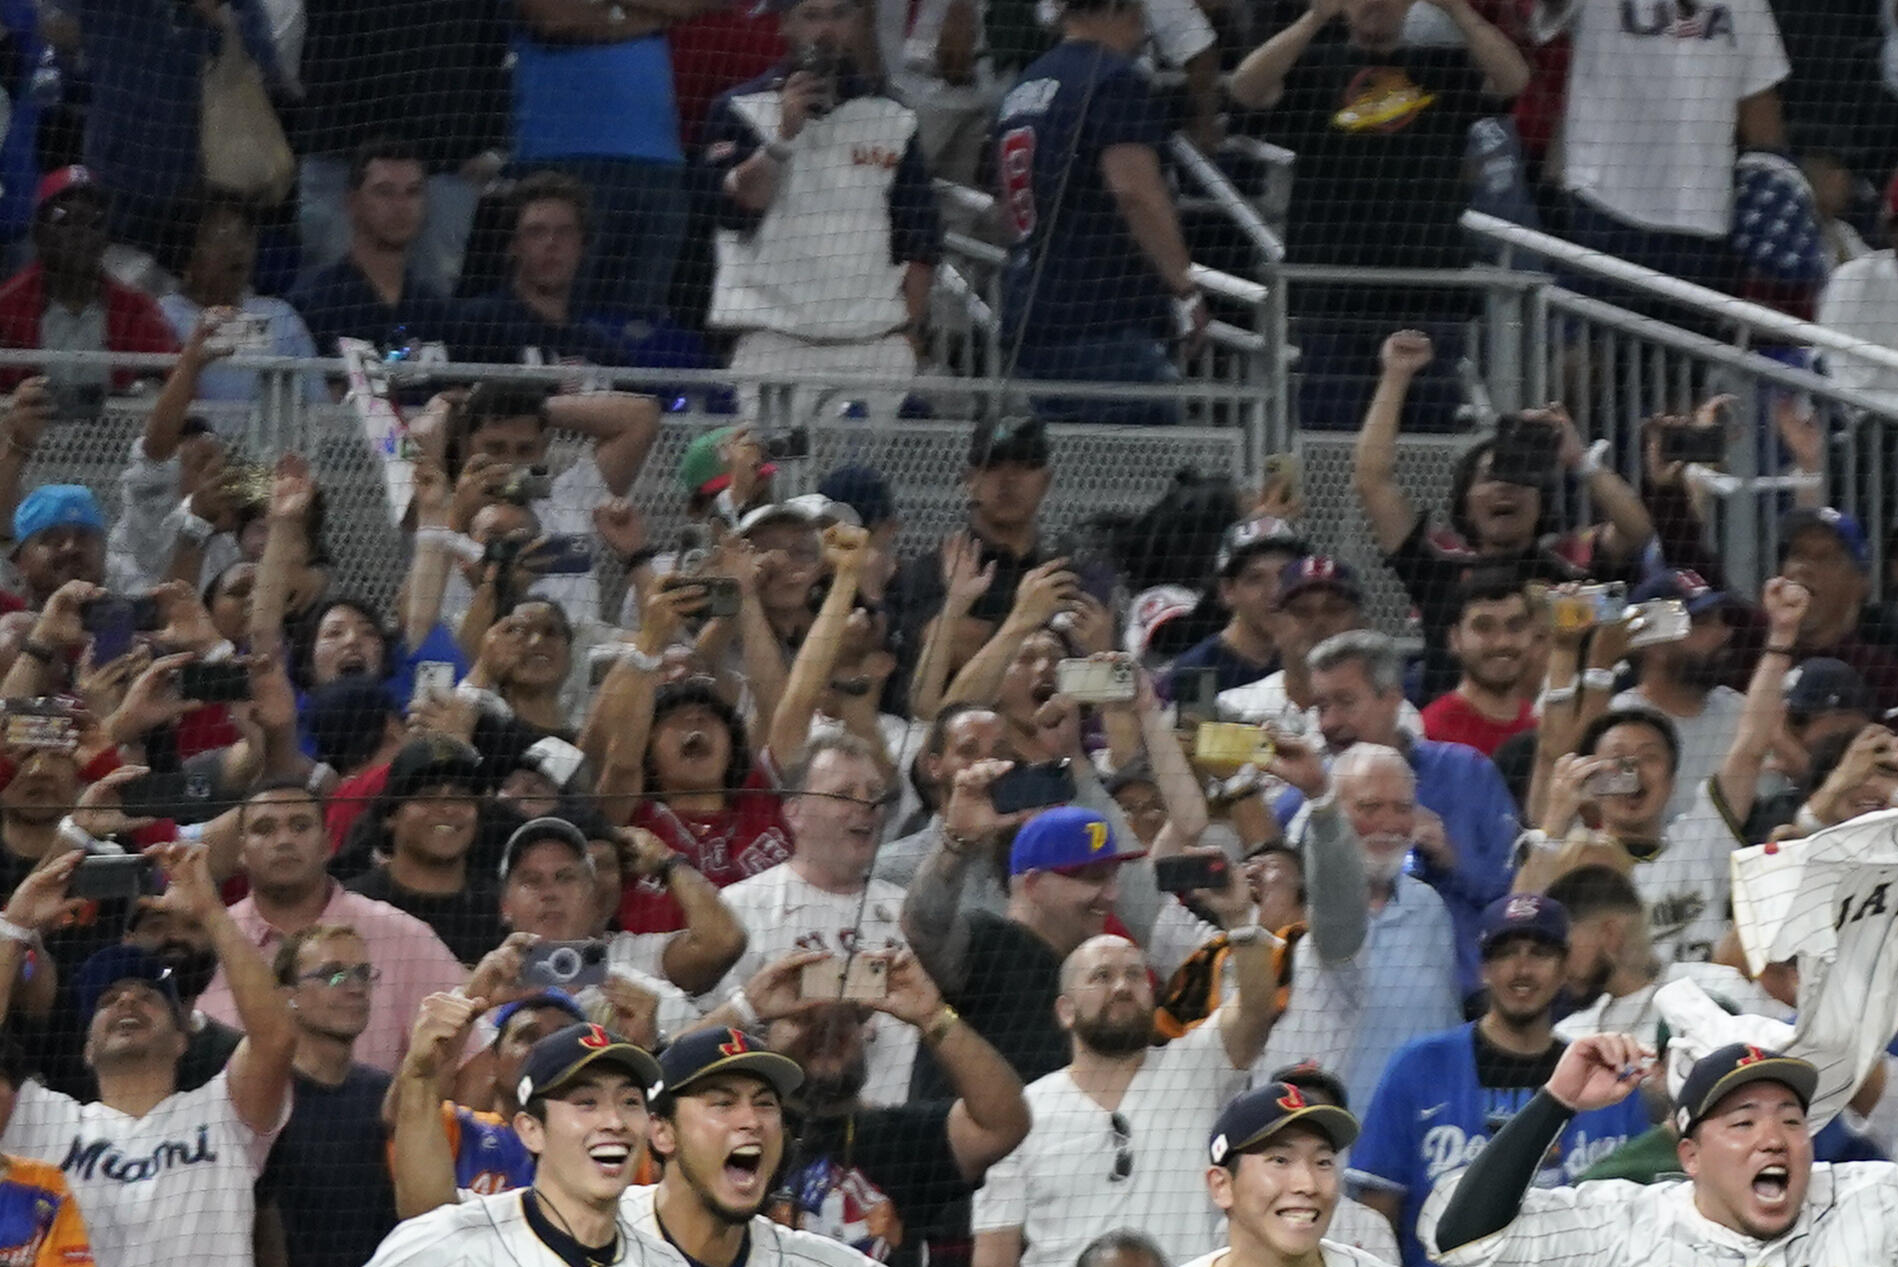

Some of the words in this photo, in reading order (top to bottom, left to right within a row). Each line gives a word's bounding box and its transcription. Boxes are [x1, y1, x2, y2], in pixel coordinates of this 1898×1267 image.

[578, 1023, 613, 1050] J
[719, 1028, 753, 1057] J
[1276, 1082, 1305, 1113] J
[60, 1122, 218, 1184] Miami
